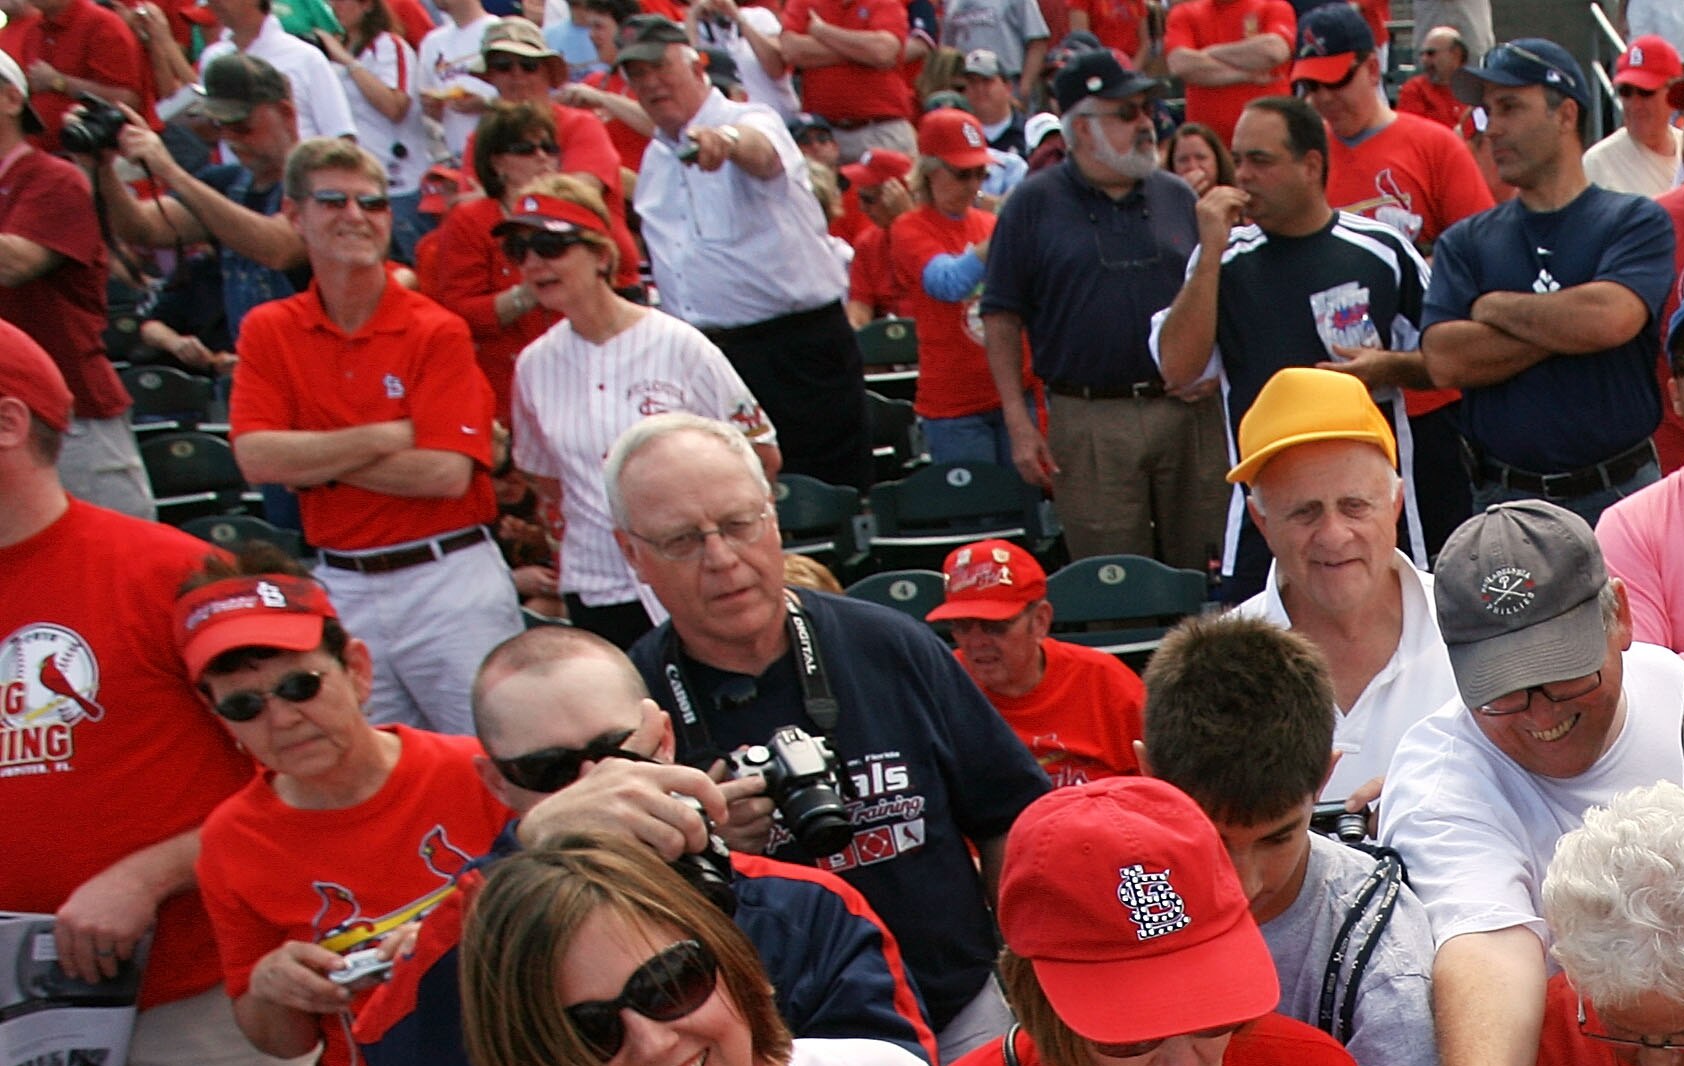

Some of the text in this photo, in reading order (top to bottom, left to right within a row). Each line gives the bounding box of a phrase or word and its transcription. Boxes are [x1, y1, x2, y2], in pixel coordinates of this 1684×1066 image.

[1486, 591, 1536, 616] PHILLIES
[792, 616, 818, 676] DIGITAL
[0, 680, 26, 716] G
[0, 722, 71, 764] ING
[843, 795, 926, 825] Training
